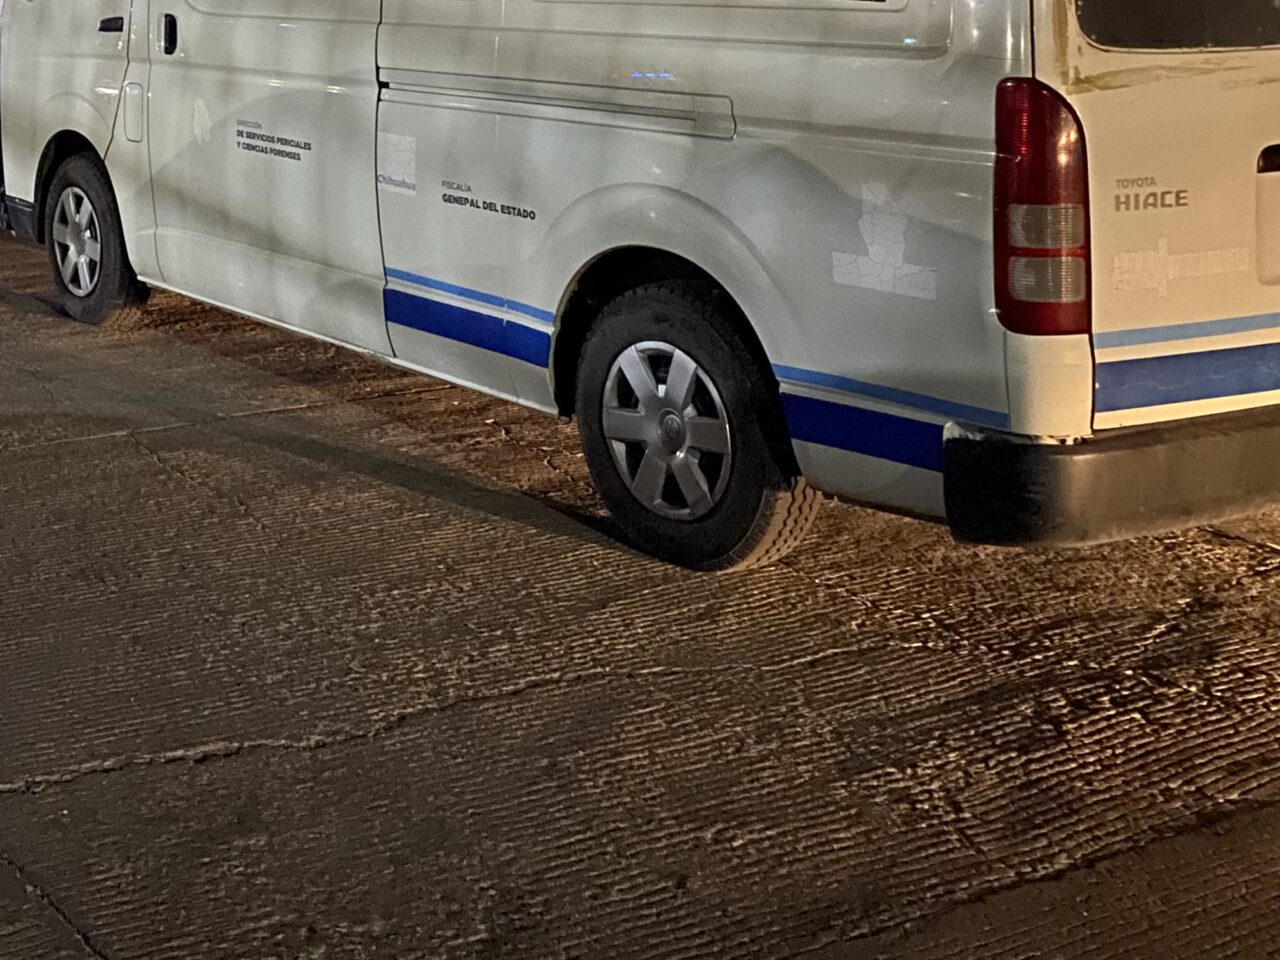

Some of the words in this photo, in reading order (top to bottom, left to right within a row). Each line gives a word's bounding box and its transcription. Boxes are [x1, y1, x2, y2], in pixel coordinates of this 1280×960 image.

[236, 129, 244, 138] DE
[245, 131, 275, 144] SERVICIOS
[276, 137, 312, 151] PERICIALES
[236, 141, 241, 149] Y
[242, 142, 268, 155] CIENCIAS
[269, 147, 301, 161] FORENSES
[1115, 177, 1157, 189] TOYOTA
[482, 200, 499, 213] DEL
[500, 204, 536, 220] ESTADO
[1114, 190, 1189, 212] HIACE
